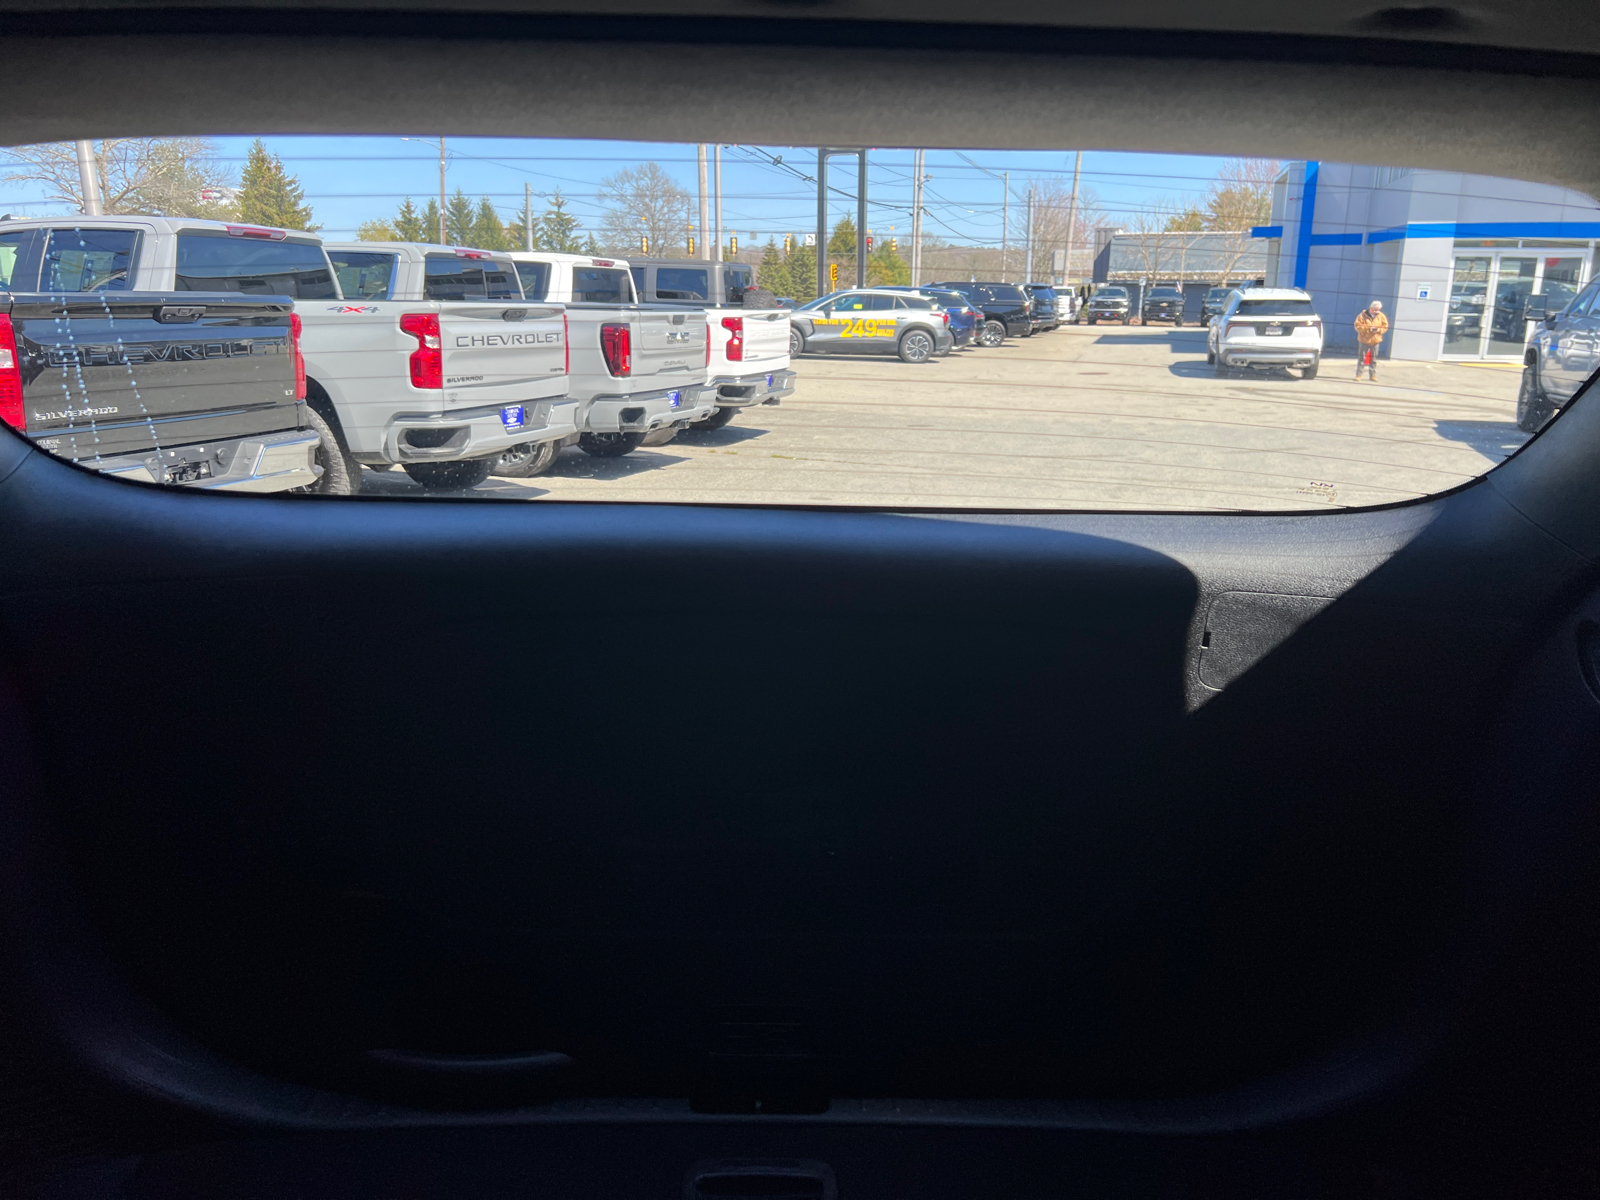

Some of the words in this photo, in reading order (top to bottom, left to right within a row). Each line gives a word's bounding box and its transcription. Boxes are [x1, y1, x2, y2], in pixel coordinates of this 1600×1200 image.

[456, 333, 562, 348] CHEVROLET
[48, 338, 289, 368] CHEVROLET
[446, 375, 484, 384] SILVERADO
[35, 405, 118, 421] SILVERADO
